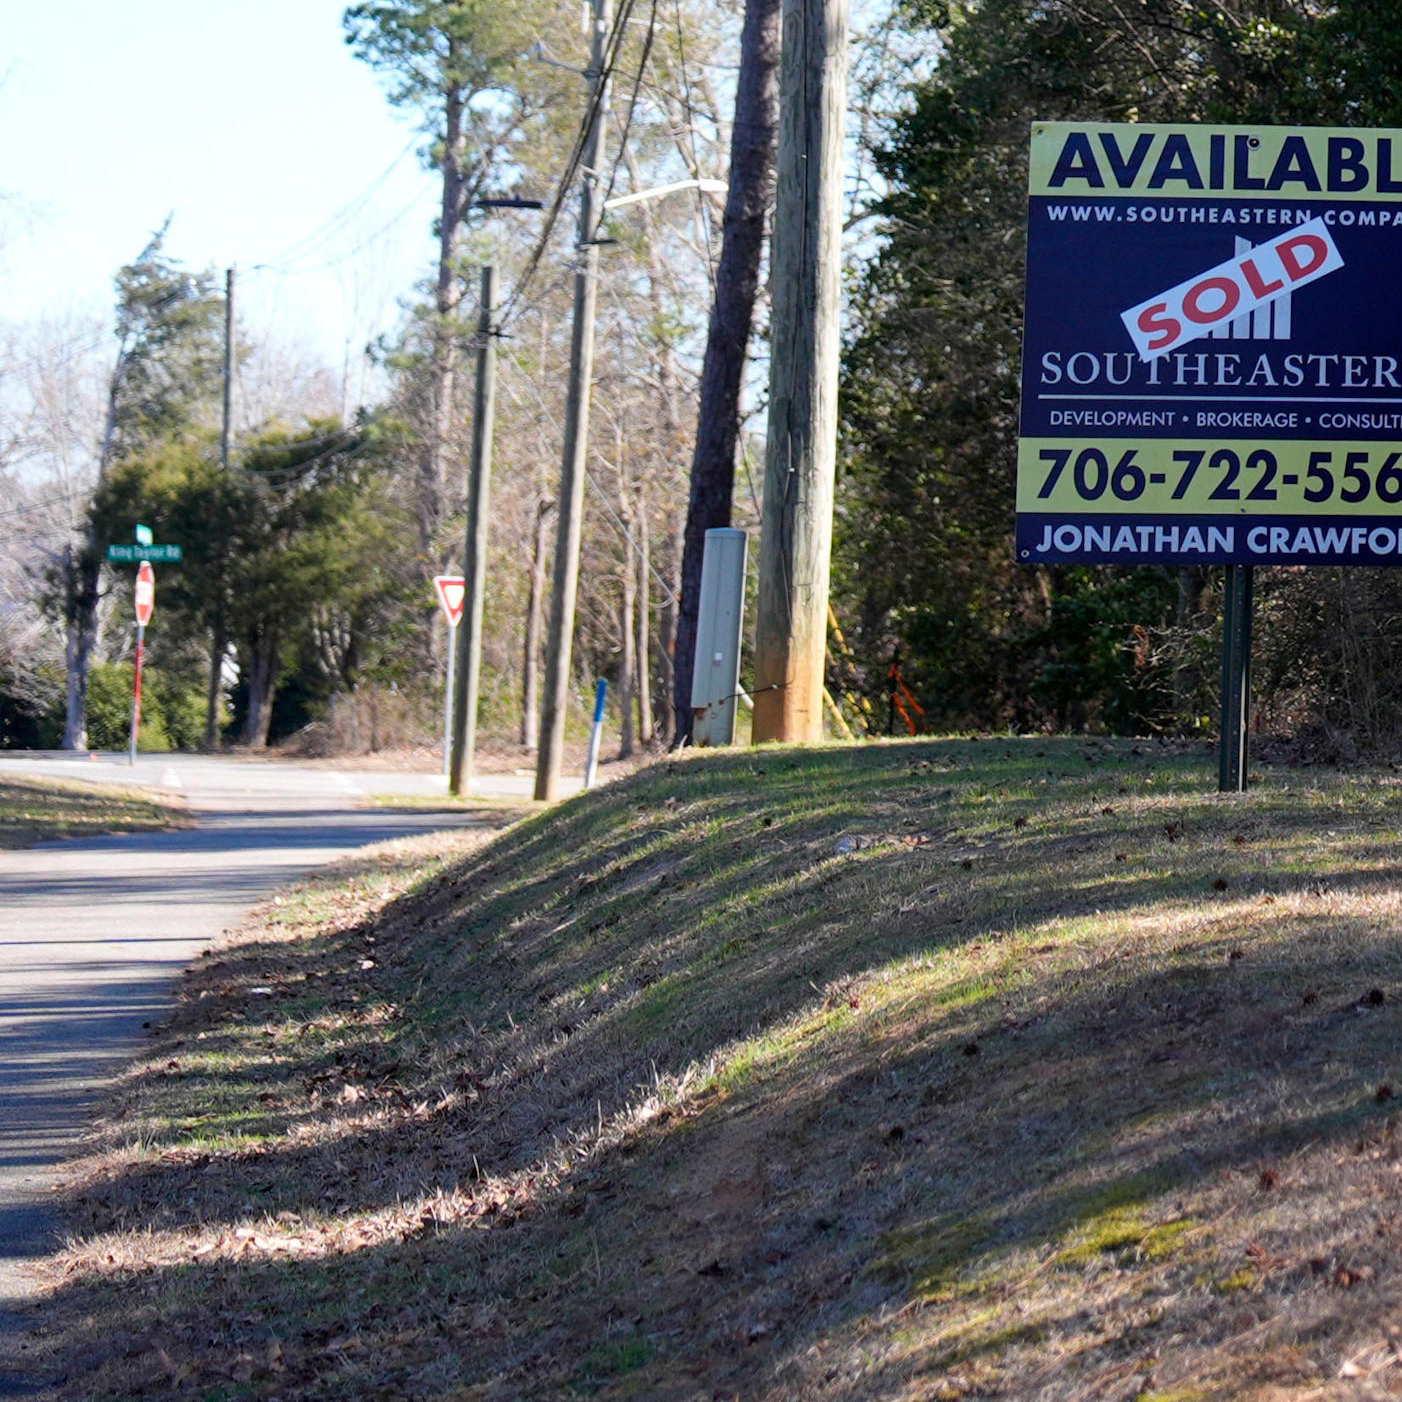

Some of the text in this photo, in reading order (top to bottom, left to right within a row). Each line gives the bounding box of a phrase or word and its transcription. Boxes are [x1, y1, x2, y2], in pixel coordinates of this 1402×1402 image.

[1136, 233, 1329, 350] SOLD
[1049, 410, 1176, 427] DEVELOPMENT
[1196, 411, 1299, 428] BROKERAGE
[1035, 524, 1236, 554] JONATHAN
